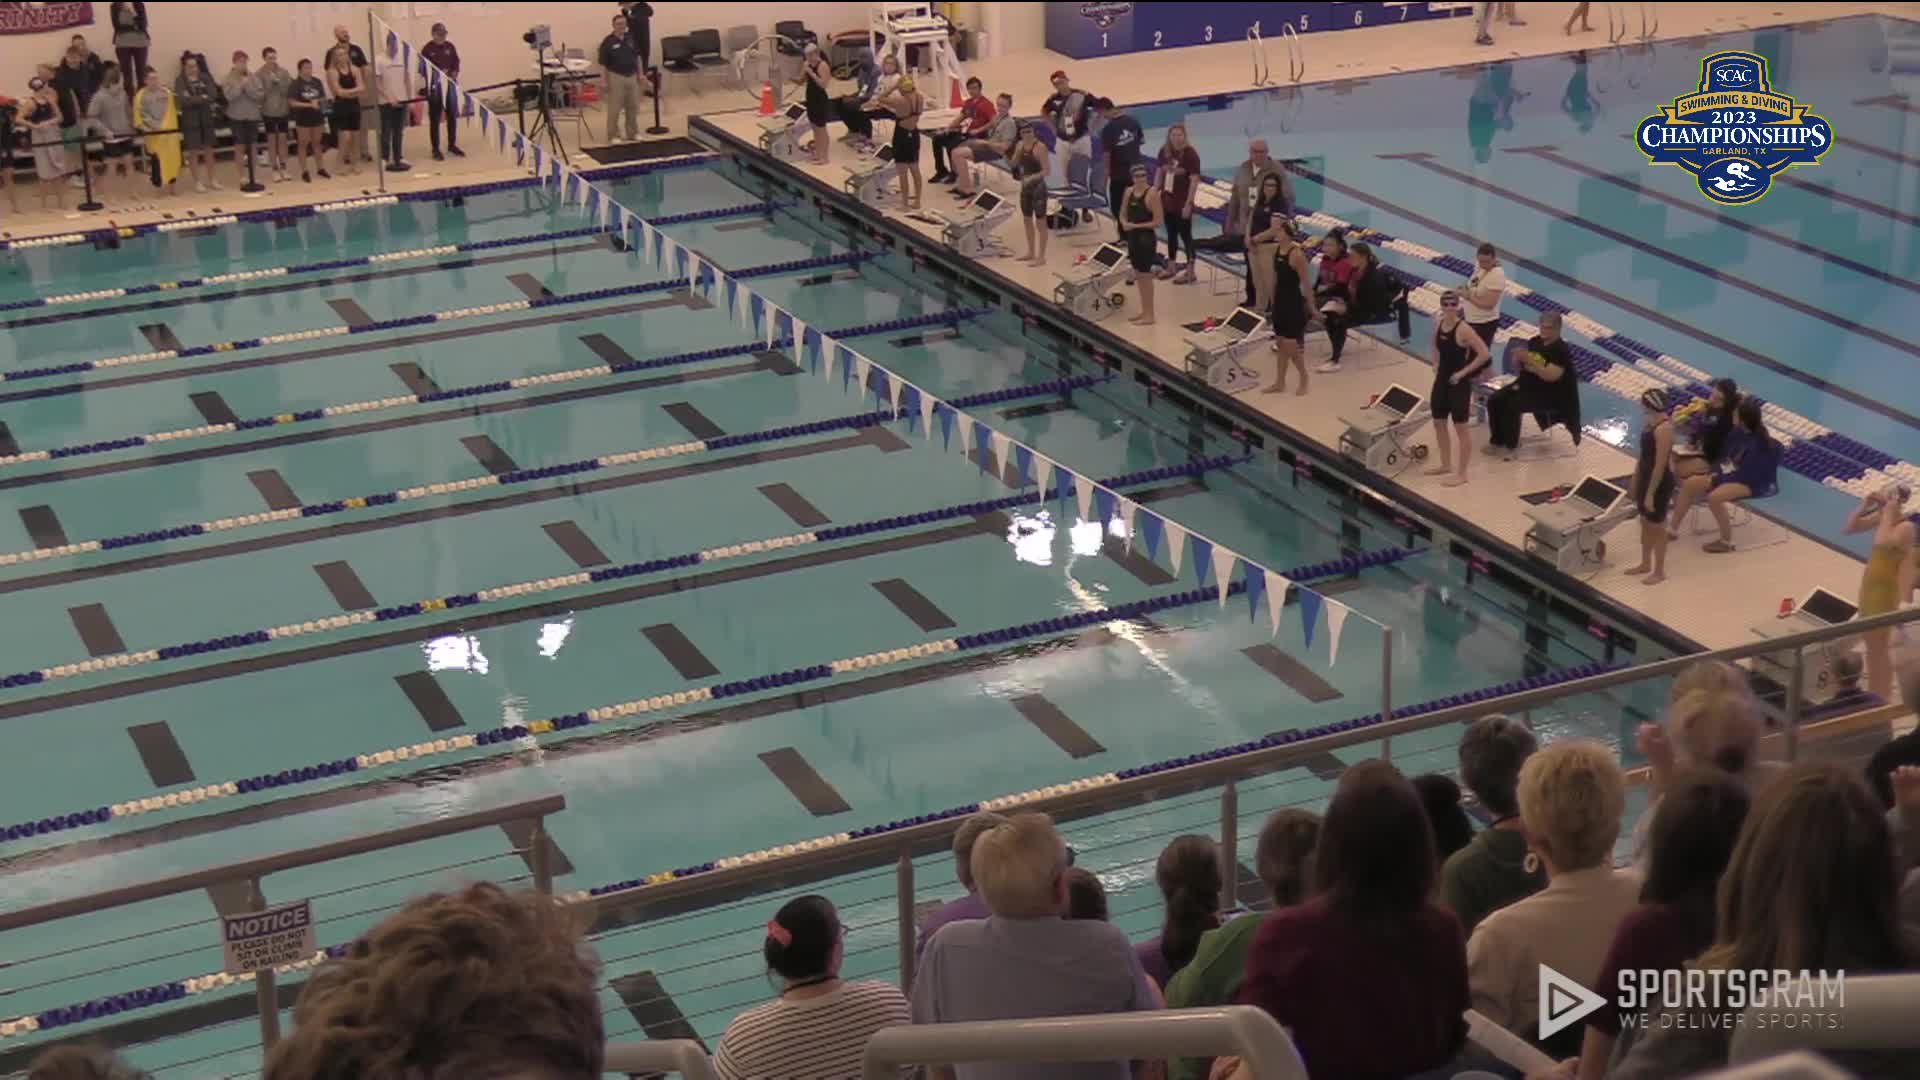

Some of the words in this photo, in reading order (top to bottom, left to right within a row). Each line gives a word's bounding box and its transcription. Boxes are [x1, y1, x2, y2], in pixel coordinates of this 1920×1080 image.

[1354, 10, 1362, 26] 6
[1400, 6, 1408, 21] 7
[1300, 14, 1309, 31] 5
[1101, 32, 1108, 49] 1
[1154, 31, 1162, 47] 2
[1205, 25, 1213, 41] 3
[976, 238, 985, 252] 3
[1092, 298, 1100, 312] 4
[1227, 368, 1237, 384] 5
[1386, 448, 1397, 466] 6
[229, 907, 306, 938] NOTICE
[231, 937, 269, 952] PLEASE
[271, 934, 285, 945] DO
[288, 928, 306, 938] NOT
[237, 951, 252, 962] SIT
[254, 948, 269, 958] OR
[271, 940, 303, 954] CLIMB
[242, 960, 257, 970] ON
[260, 950, 299, 966] RAILING
